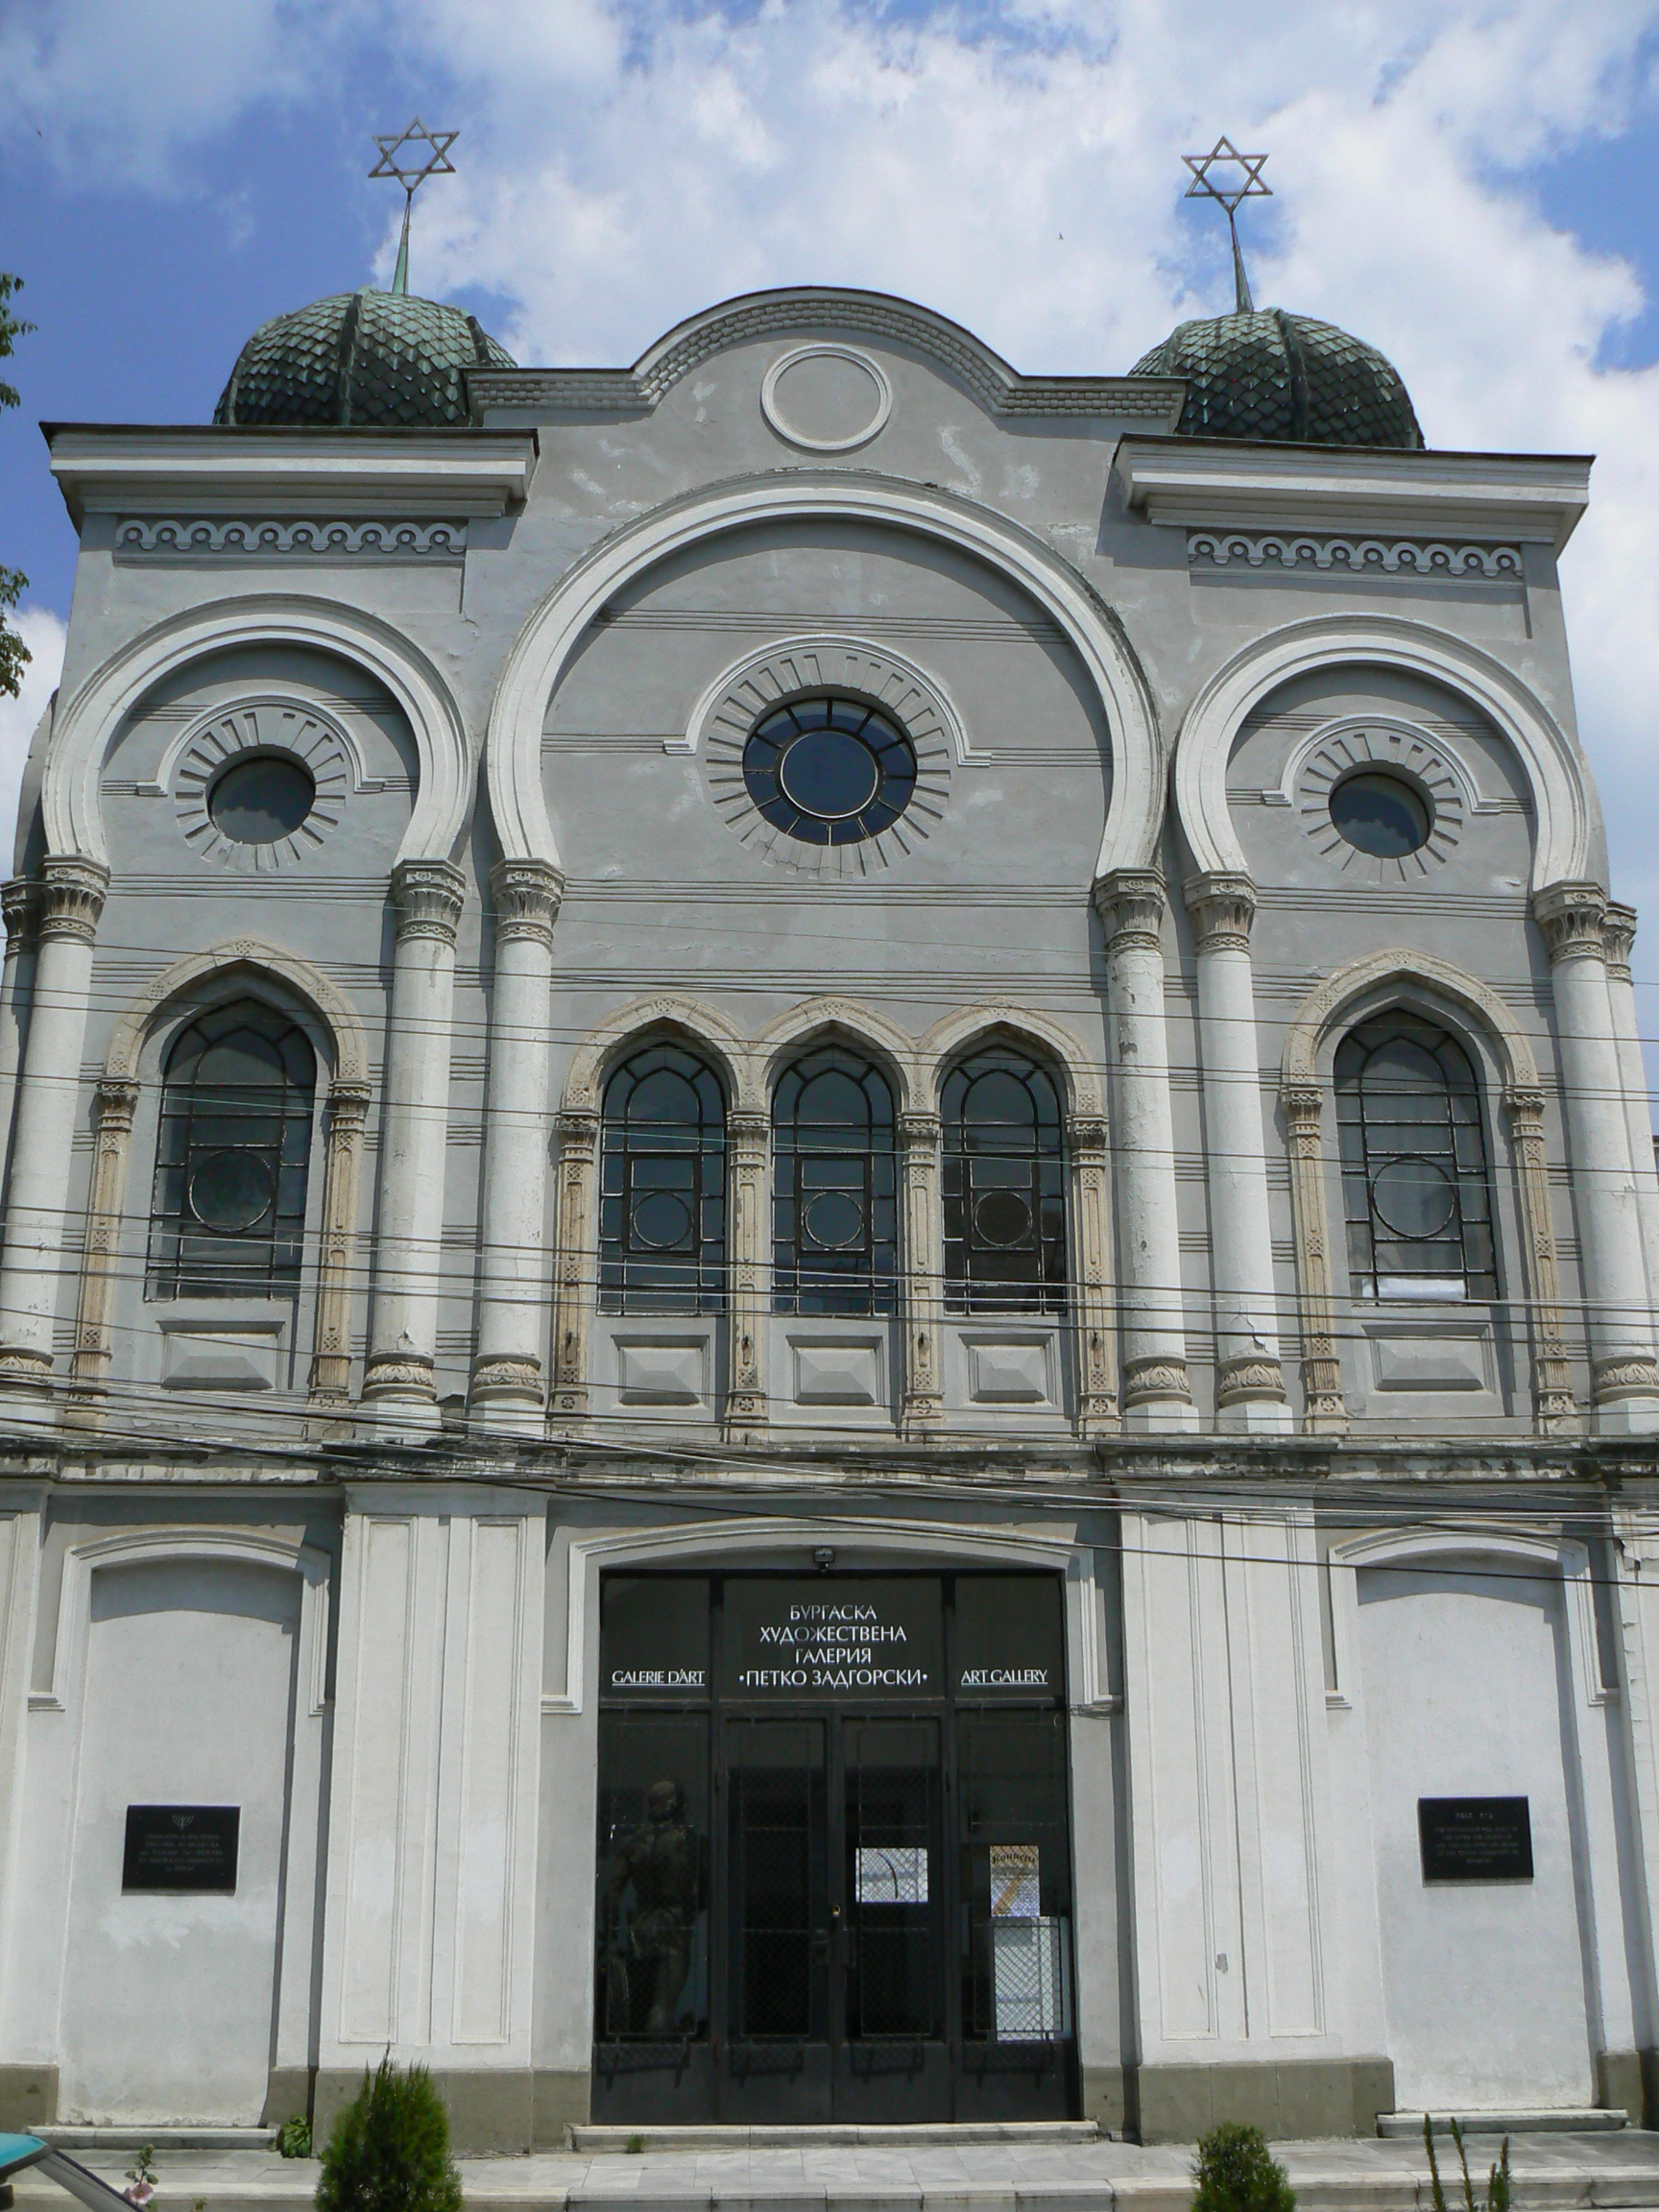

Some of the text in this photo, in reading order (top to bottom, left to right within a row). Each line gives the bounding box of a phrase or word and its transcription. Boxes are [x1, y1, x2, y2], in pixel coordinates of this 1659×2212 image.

[790, 1604, 878, 1621] БУРГАСКА
[759, 1625, 907, 1646] ХУДОЖЕСТВЕНА
[795, 1647, 872, 1665] ГАЛЕРИЯ
[612, 1668, 706, 1684] GALERIE D'ART
[961, 1669, 1047, 1683] ART GALLERY
